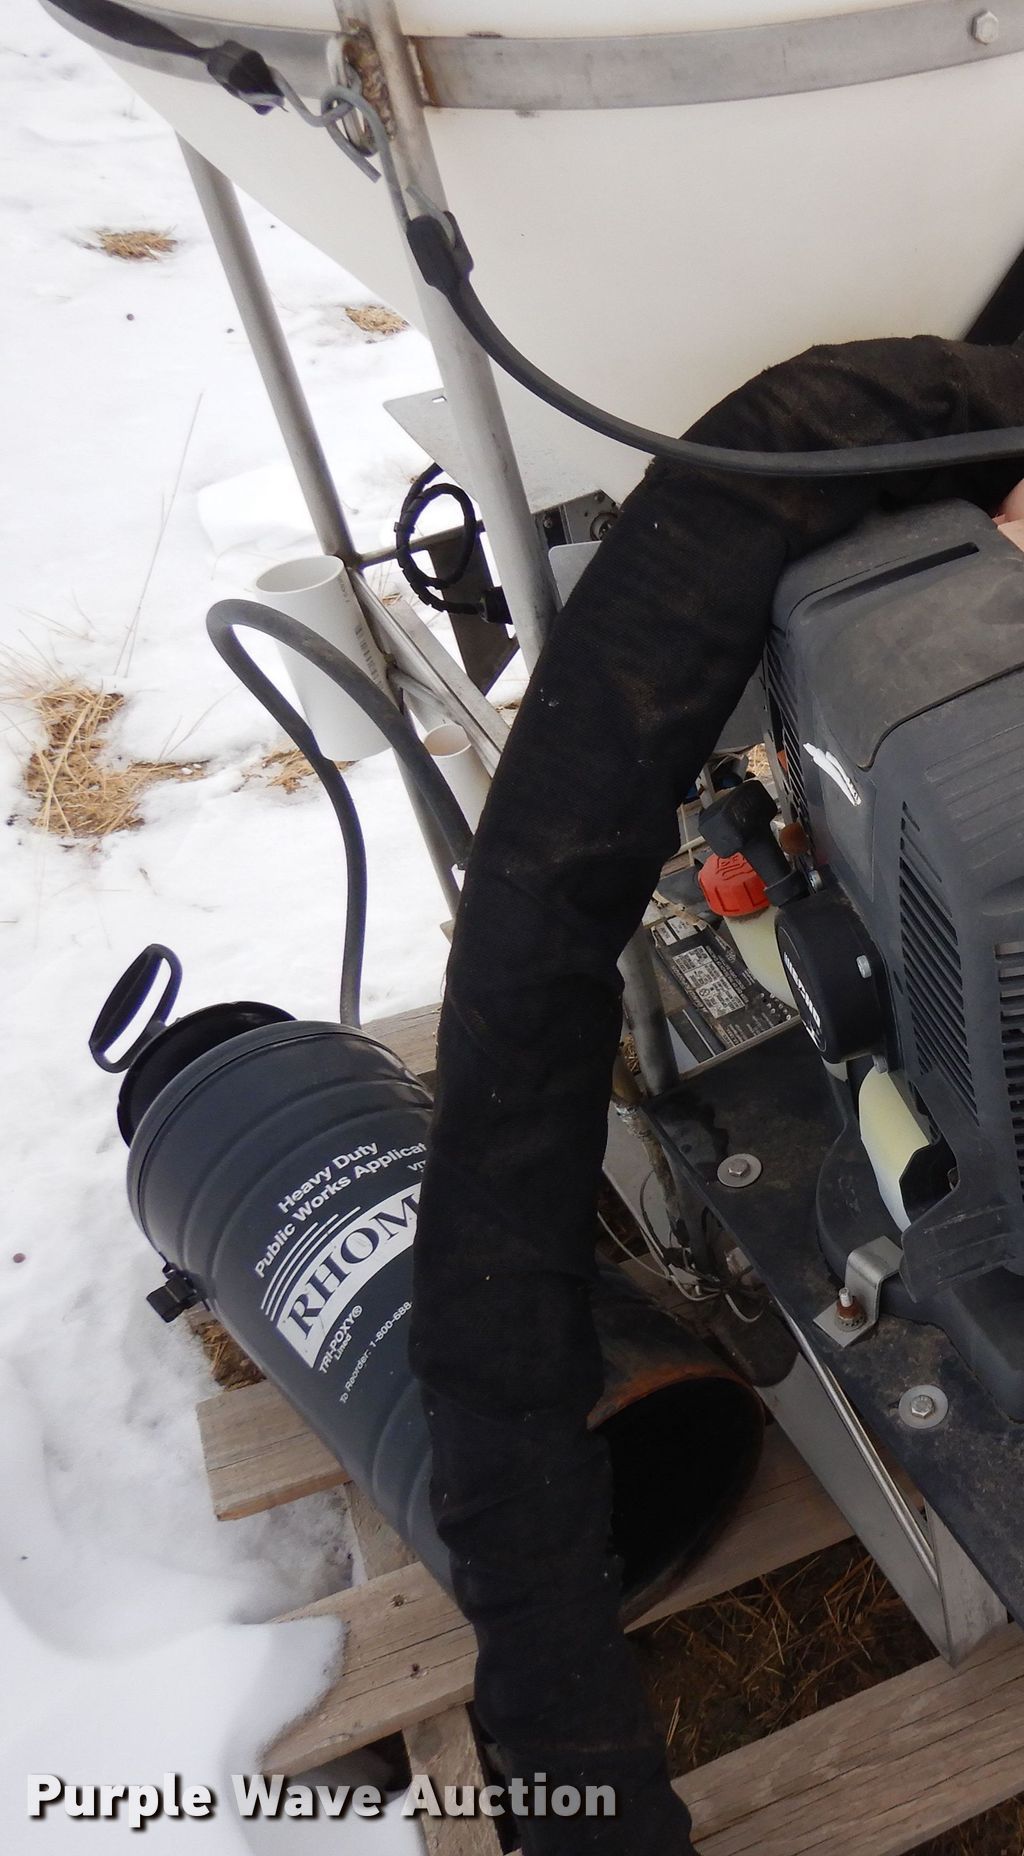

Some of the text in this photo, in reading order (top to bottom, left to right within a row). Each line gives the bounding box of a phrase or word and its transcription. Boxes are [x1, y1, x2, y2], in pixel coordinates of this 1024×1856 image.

[278, 1166, 332, 1213] Heavy
[332, 1142, 378, 1169] Duty
[255, 1223, 296, 1278] Public
[292, 1176, 352, 1222] Works
[334, 1334, 352, 1361] Lined
[339, 1392, 349, 1404] To
[345, 1349, 372, 1391] Reorder:
